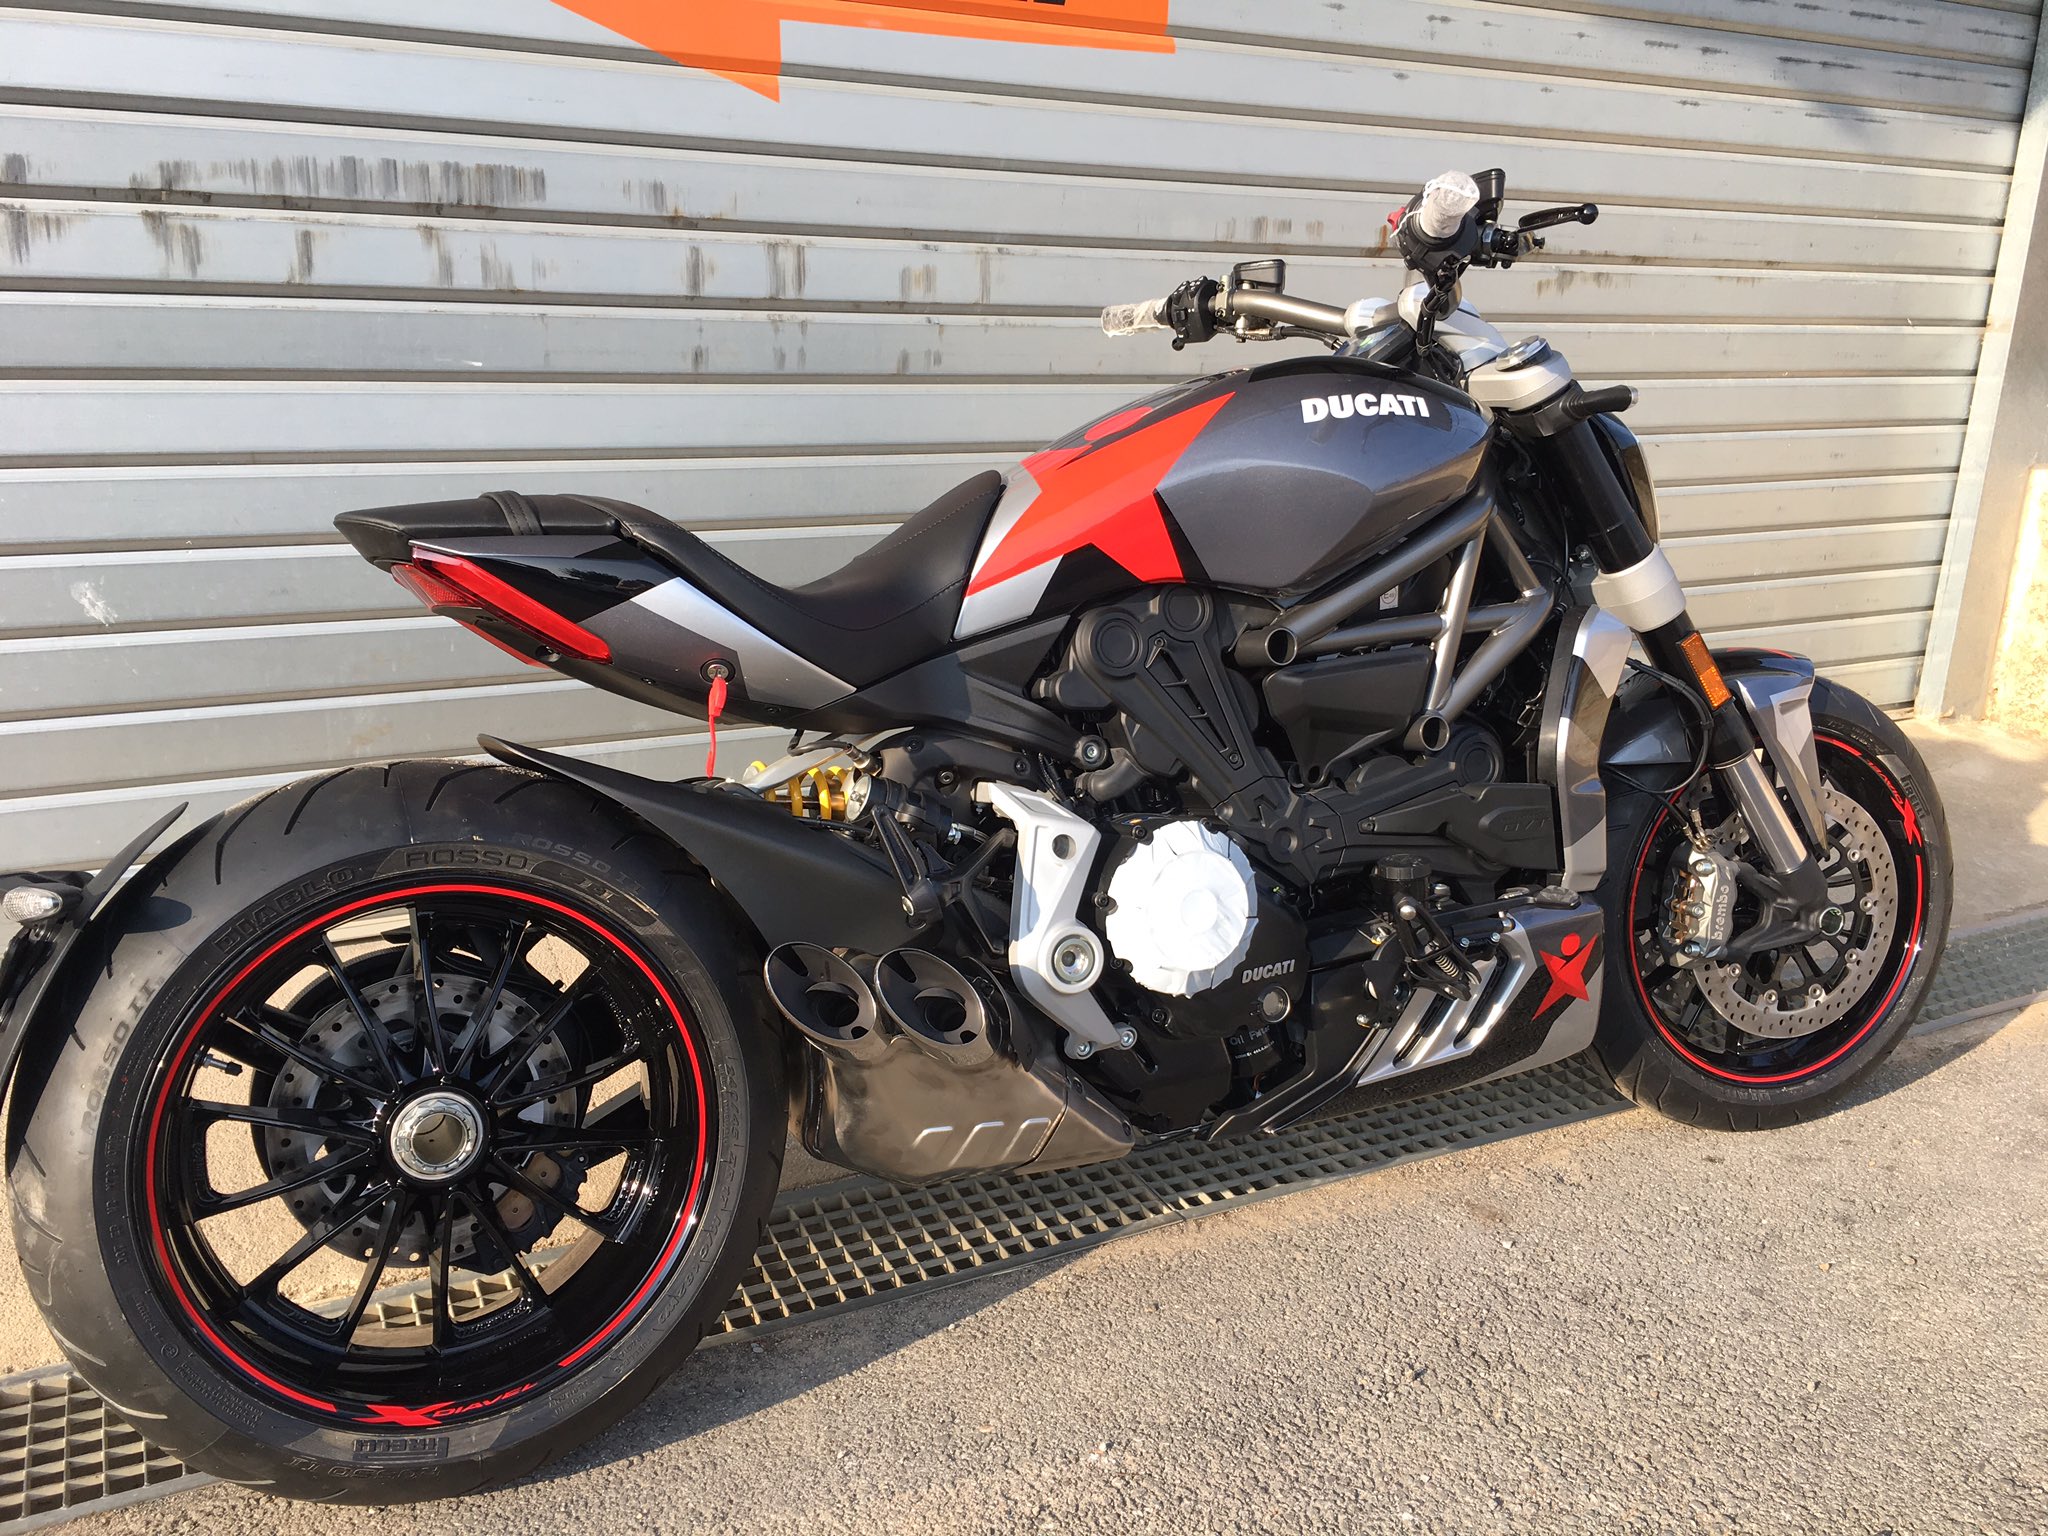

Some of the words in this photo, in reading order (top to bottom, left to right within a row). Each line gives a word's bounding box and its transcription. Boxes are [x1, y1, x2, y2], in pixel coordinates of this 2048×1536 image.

[1301, 393, 1430, 423] DUCATI
[212, 866, 355, 953] DIABLO
[404, 848, 529, 870] ROSSO
[1711, 884, 1730, 940] brembo
[1242, 959, 1296, 984] DUCATI
